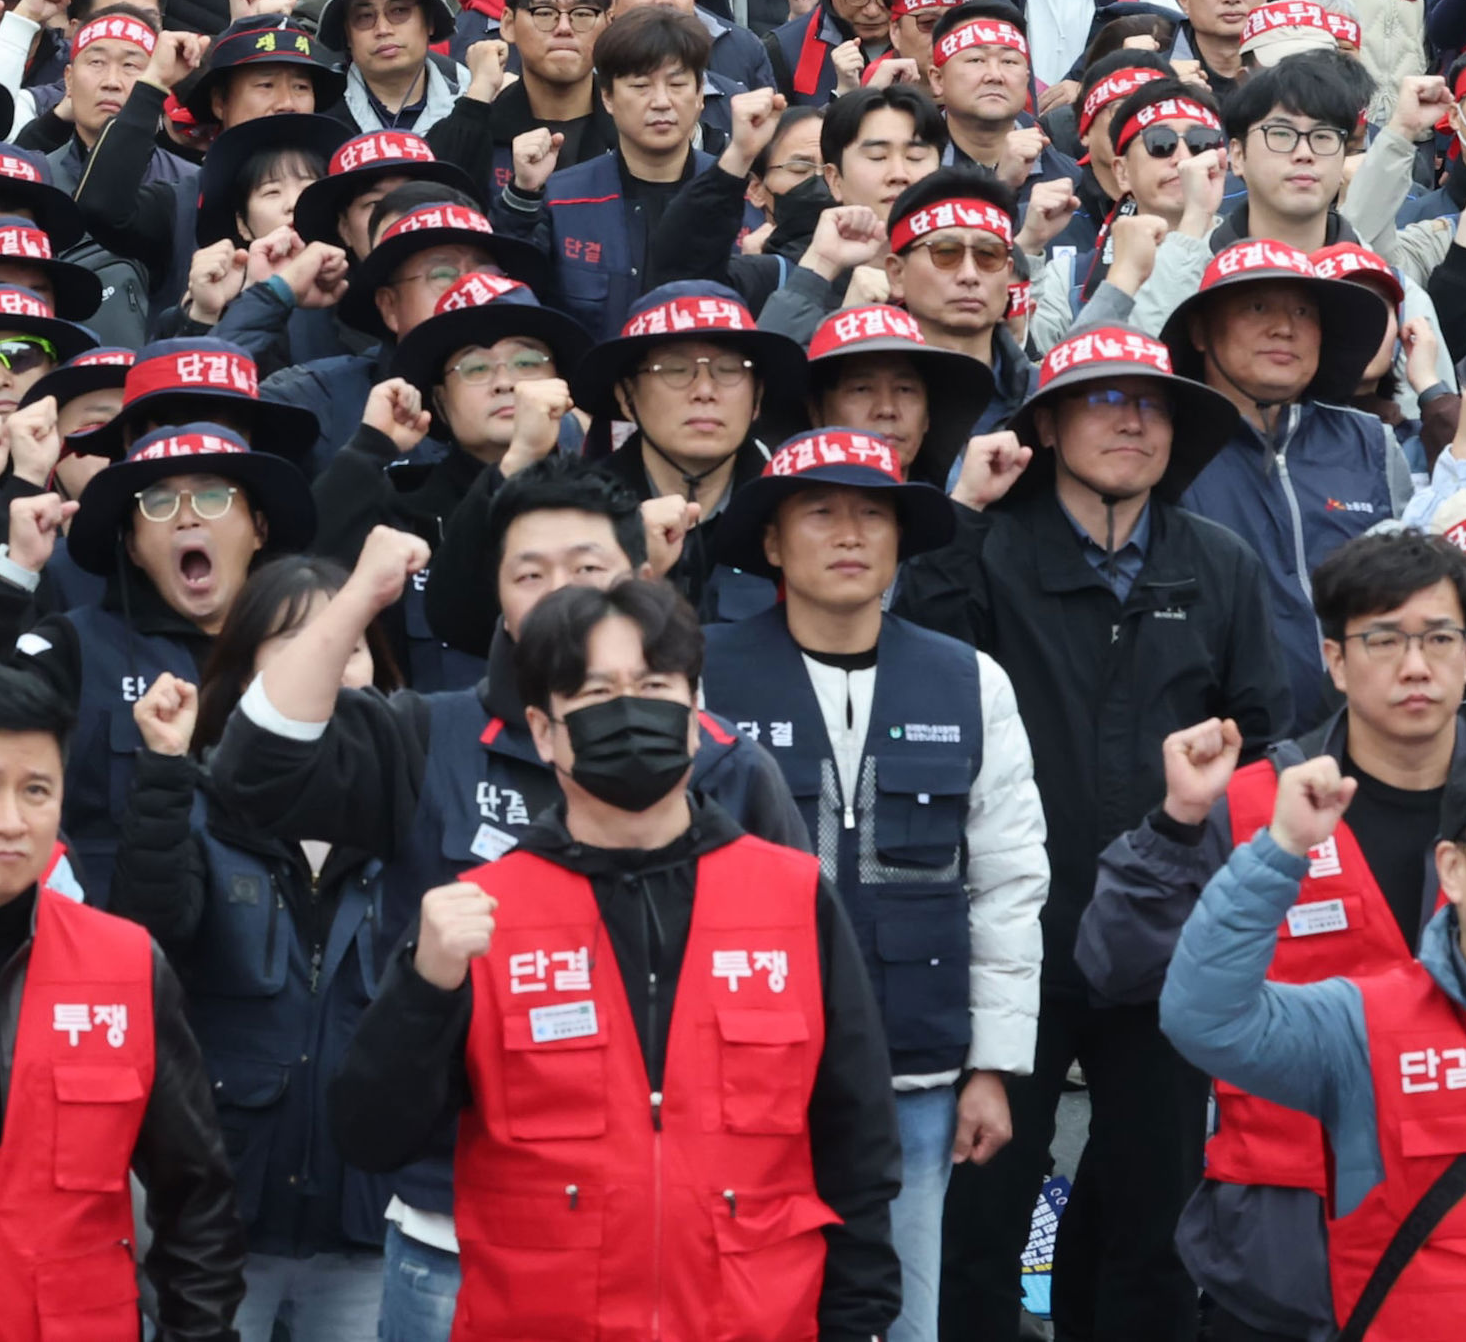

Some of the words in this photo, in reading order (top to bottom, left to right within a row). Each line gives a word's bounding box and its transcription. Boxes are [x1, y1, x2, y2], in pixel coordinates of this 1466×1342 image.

[563, 236, 602, 264] 단결
[475, 781, 531, 826] 단결
[509, 947, 591, 995] 단결
[711, 949, 789, 993] 투쟁
[52, 1002, 128, 1049] 투쟁
